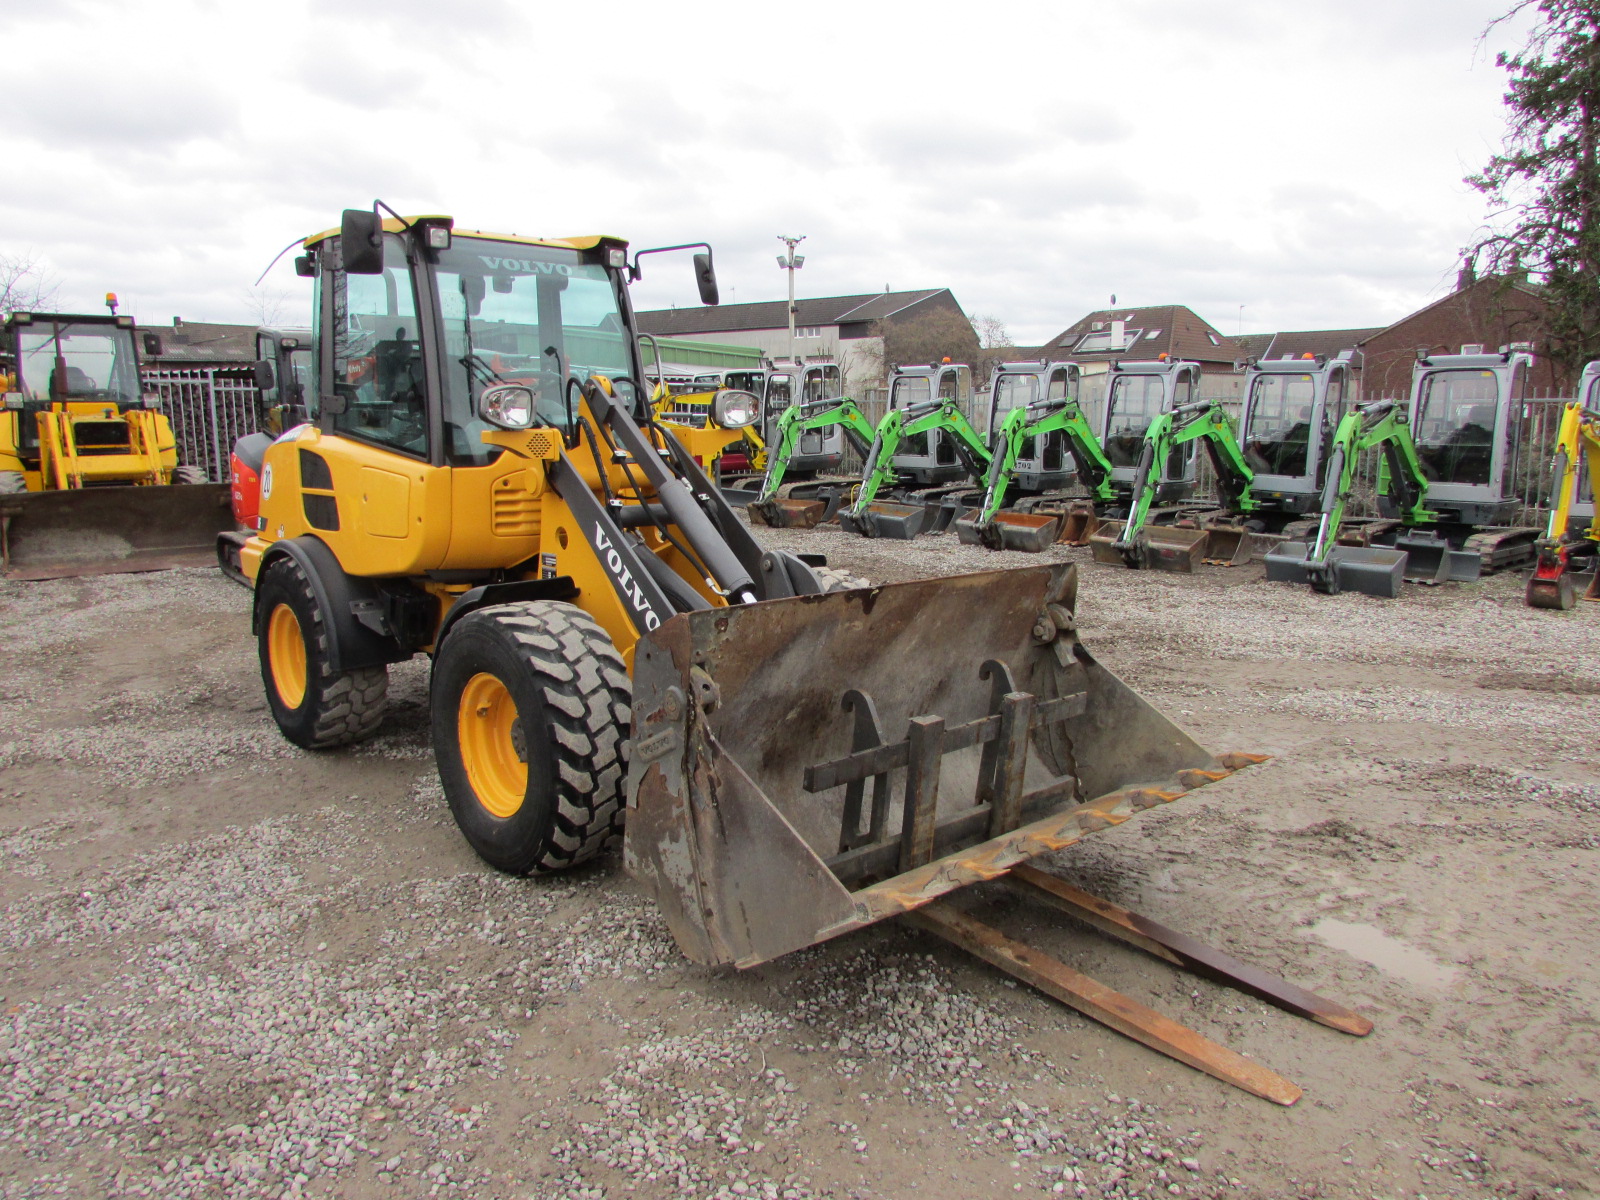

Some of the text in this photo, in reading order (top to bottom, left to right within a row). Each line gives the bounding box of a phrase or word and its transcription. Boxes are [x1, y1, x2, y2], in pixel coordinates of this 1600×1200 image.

[479, 255, 573, 276] VOLVO
[263, 469, 271, 493] 20
[595, 520, 661, 632] VOLVO
